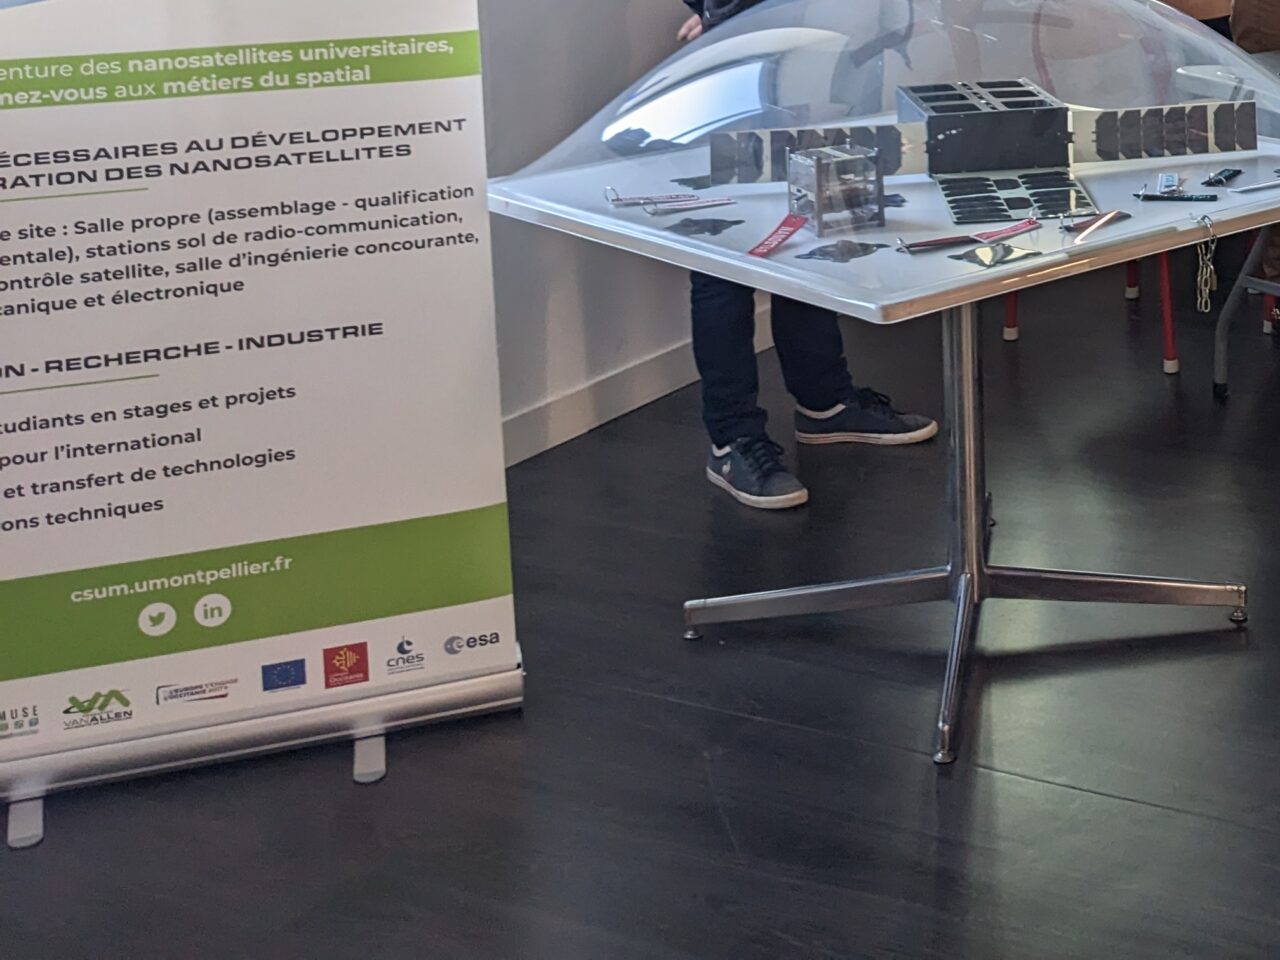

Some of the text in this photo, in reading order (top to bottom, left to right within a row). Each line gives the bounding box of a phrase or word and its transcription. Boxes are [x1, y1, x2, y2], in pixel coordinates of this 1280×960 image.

[80, 58, 121, 75] des
[128, 48, 293, 72] nanosatellites
[299, 38, 454, 61] universitaires,
[114, 80, 156, 98] aux
[163, 74, 253, 95] métiers
[259, 70, 290, 88] du
[296, 65, 371, 89] spatial
[185, 138, 224, 152] AU
[230, 119, 467, 149] DÉVELOPPEMENT
[104, 164, 163, 182] DES
[169, 144, 412, 176] NANOSATELLITES
[17, 224, 57, 240] site
[74, 217, 124, 235] Salle
[131, 210, 201, 233] propre
[207, 198, 336, 224] (assemblage
[354, 185, 475, 211] qualification
[85, 238, 171, 259] stations
[177, 233, 206, 250] sol
[212, 230, 238, 246] de
[244, 210, 463, 243] radio-communication,
[80, 262, 169, 285] satellite,
[175, 257, 223, 274] salle
[228, 244, 349, 272] d'ingénierie
[354, 230, 479, 257] concourante,
[83, 293, 105, 308] et
[111, 280, 245, 306] électronique
[44, 342, 221, 374] RECHERCHE
[238, 322, 384, 351] INDUSTRIE
[91, 410, 117, 423] en
[123, 398, 193, 422] stages
[198, 394, 220, 410] et
[224, 385, 297, 408] projets
[0, 428, 202, 472] pour l'international
[4, 446, 297, 499] et transfert de technologies
[46, 496, 165, 526] techniques
[70, 555, 293, 603] csum.umontpellier.fr
[466, 631, 500, 648] esa
[387, 652, 425, 667] cnes
